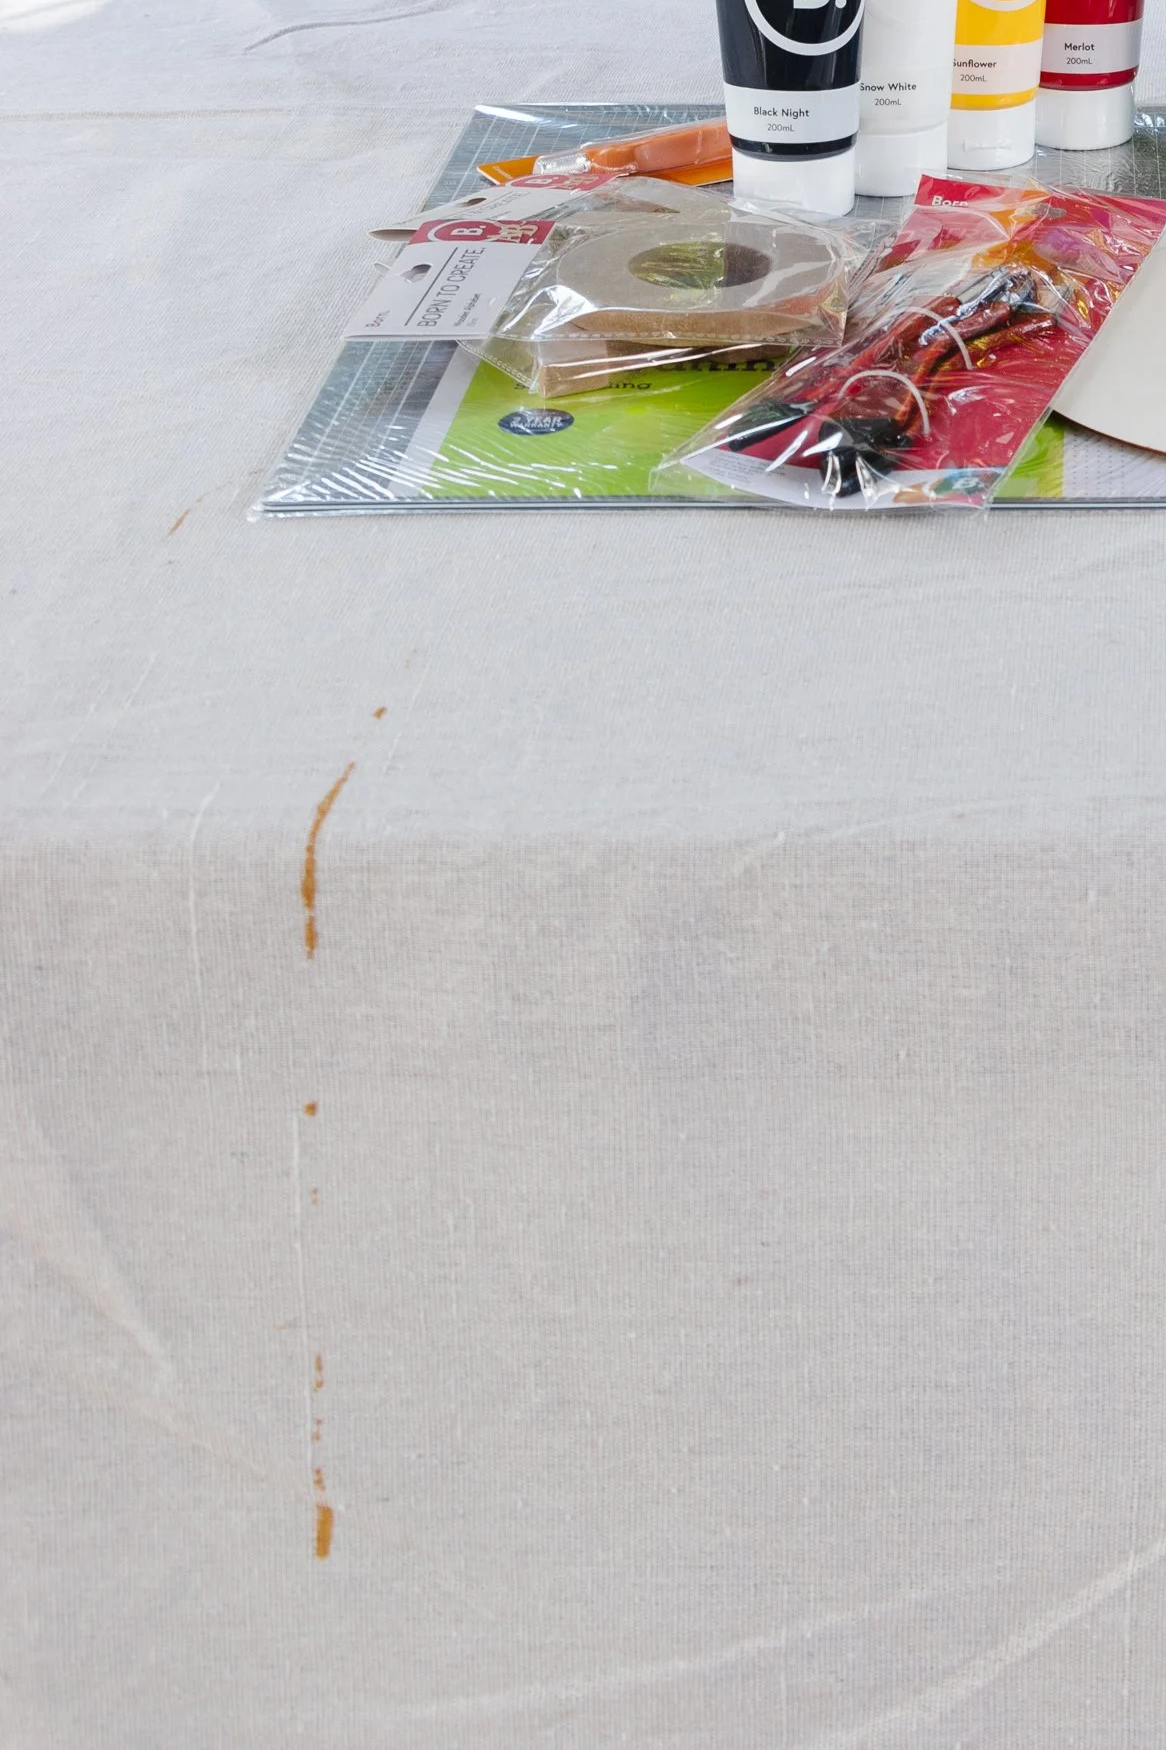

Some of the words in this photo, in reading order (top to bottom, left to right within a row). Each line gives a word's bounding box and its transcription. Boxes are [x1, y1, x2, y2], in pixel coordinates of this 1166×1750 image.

[1064, 42, 1095, 52] Merlot
[1066, 57, 1093, 65] 200mL
[960, 74, 987, 82] 200mL
[860, 82, 885, 92] Snow
[887, 81, 917, 91] White
[874, 98, 902, 107] 200mL
[753, 106, 779, 118] Black
[781, 108, 810, 119] Night
[767, 123, 795, 133] 200mL
[446, 247, 486, 282] CREATE.
[436, 284, 460, 297] TO
[416, 299, 452, 327] BORN
